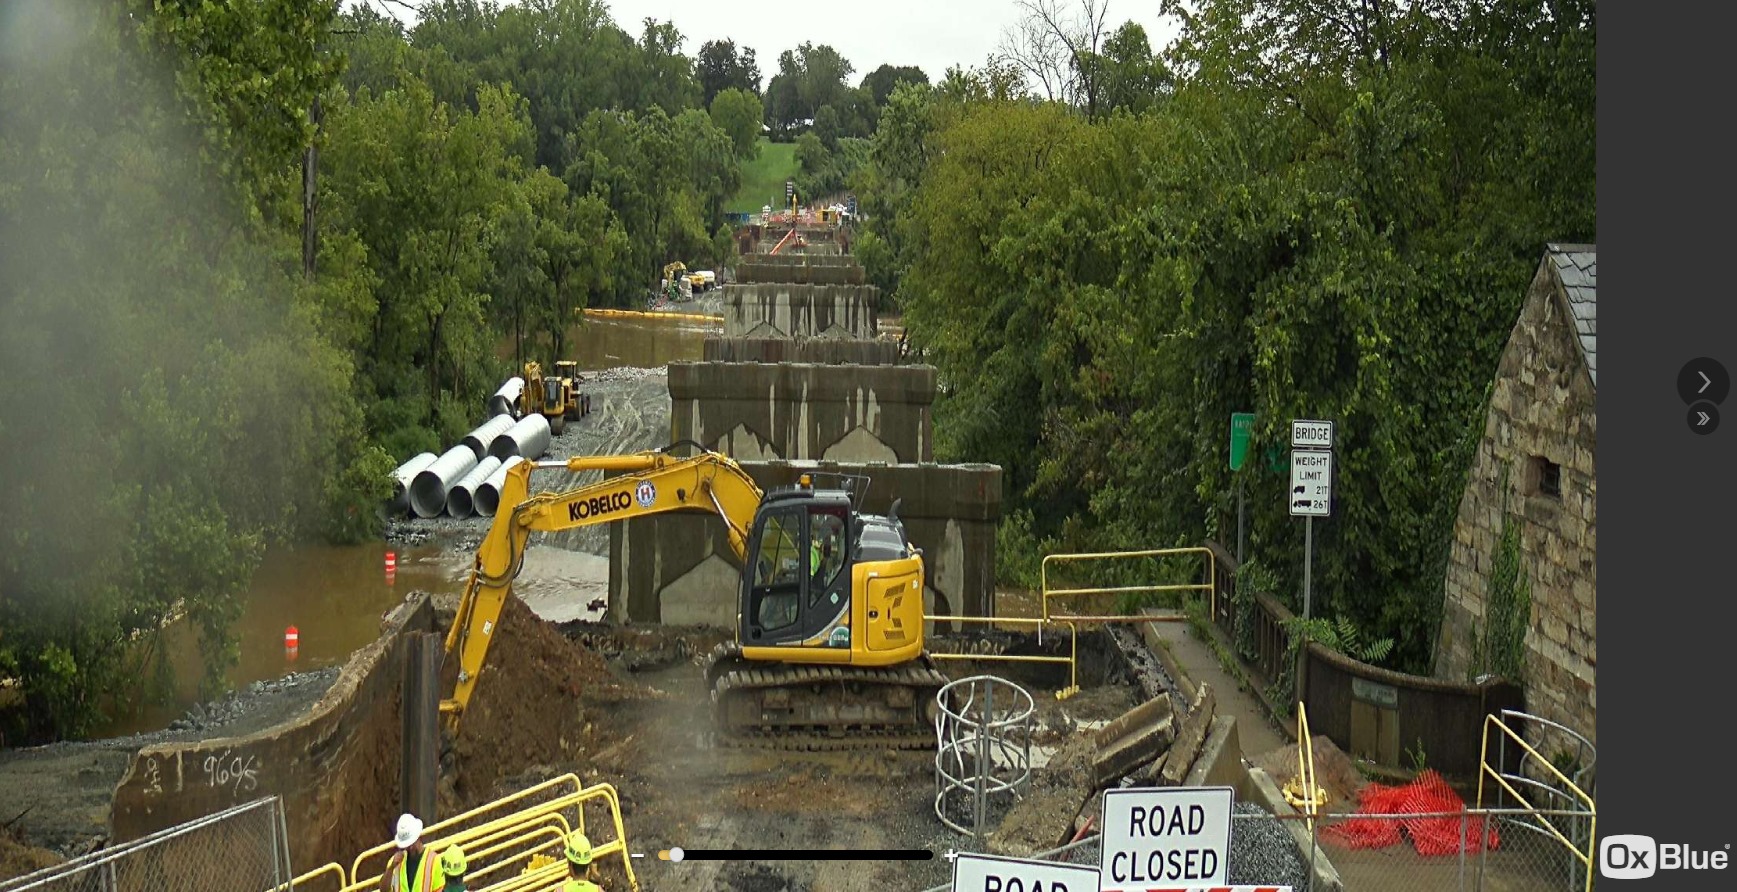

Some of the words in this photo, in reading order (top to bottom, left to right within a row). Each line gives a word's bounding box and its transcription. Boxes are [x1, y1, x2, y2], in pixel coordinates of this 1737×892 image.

[1295, 427, 1329, 440] BRIDGE
[1295, 457, 1328, 467] WEIGHT
[1299, 471, 1322, 481] LIMIT
[1316, 485, 1328, 495] 21T
[568, 491, 632, 521] KOBELCO
[1313, 499, 1328, 509] 26T
[1129, 804, 1205, 837] ROAD
[1111, 849, 1218, 882] CLOSED
